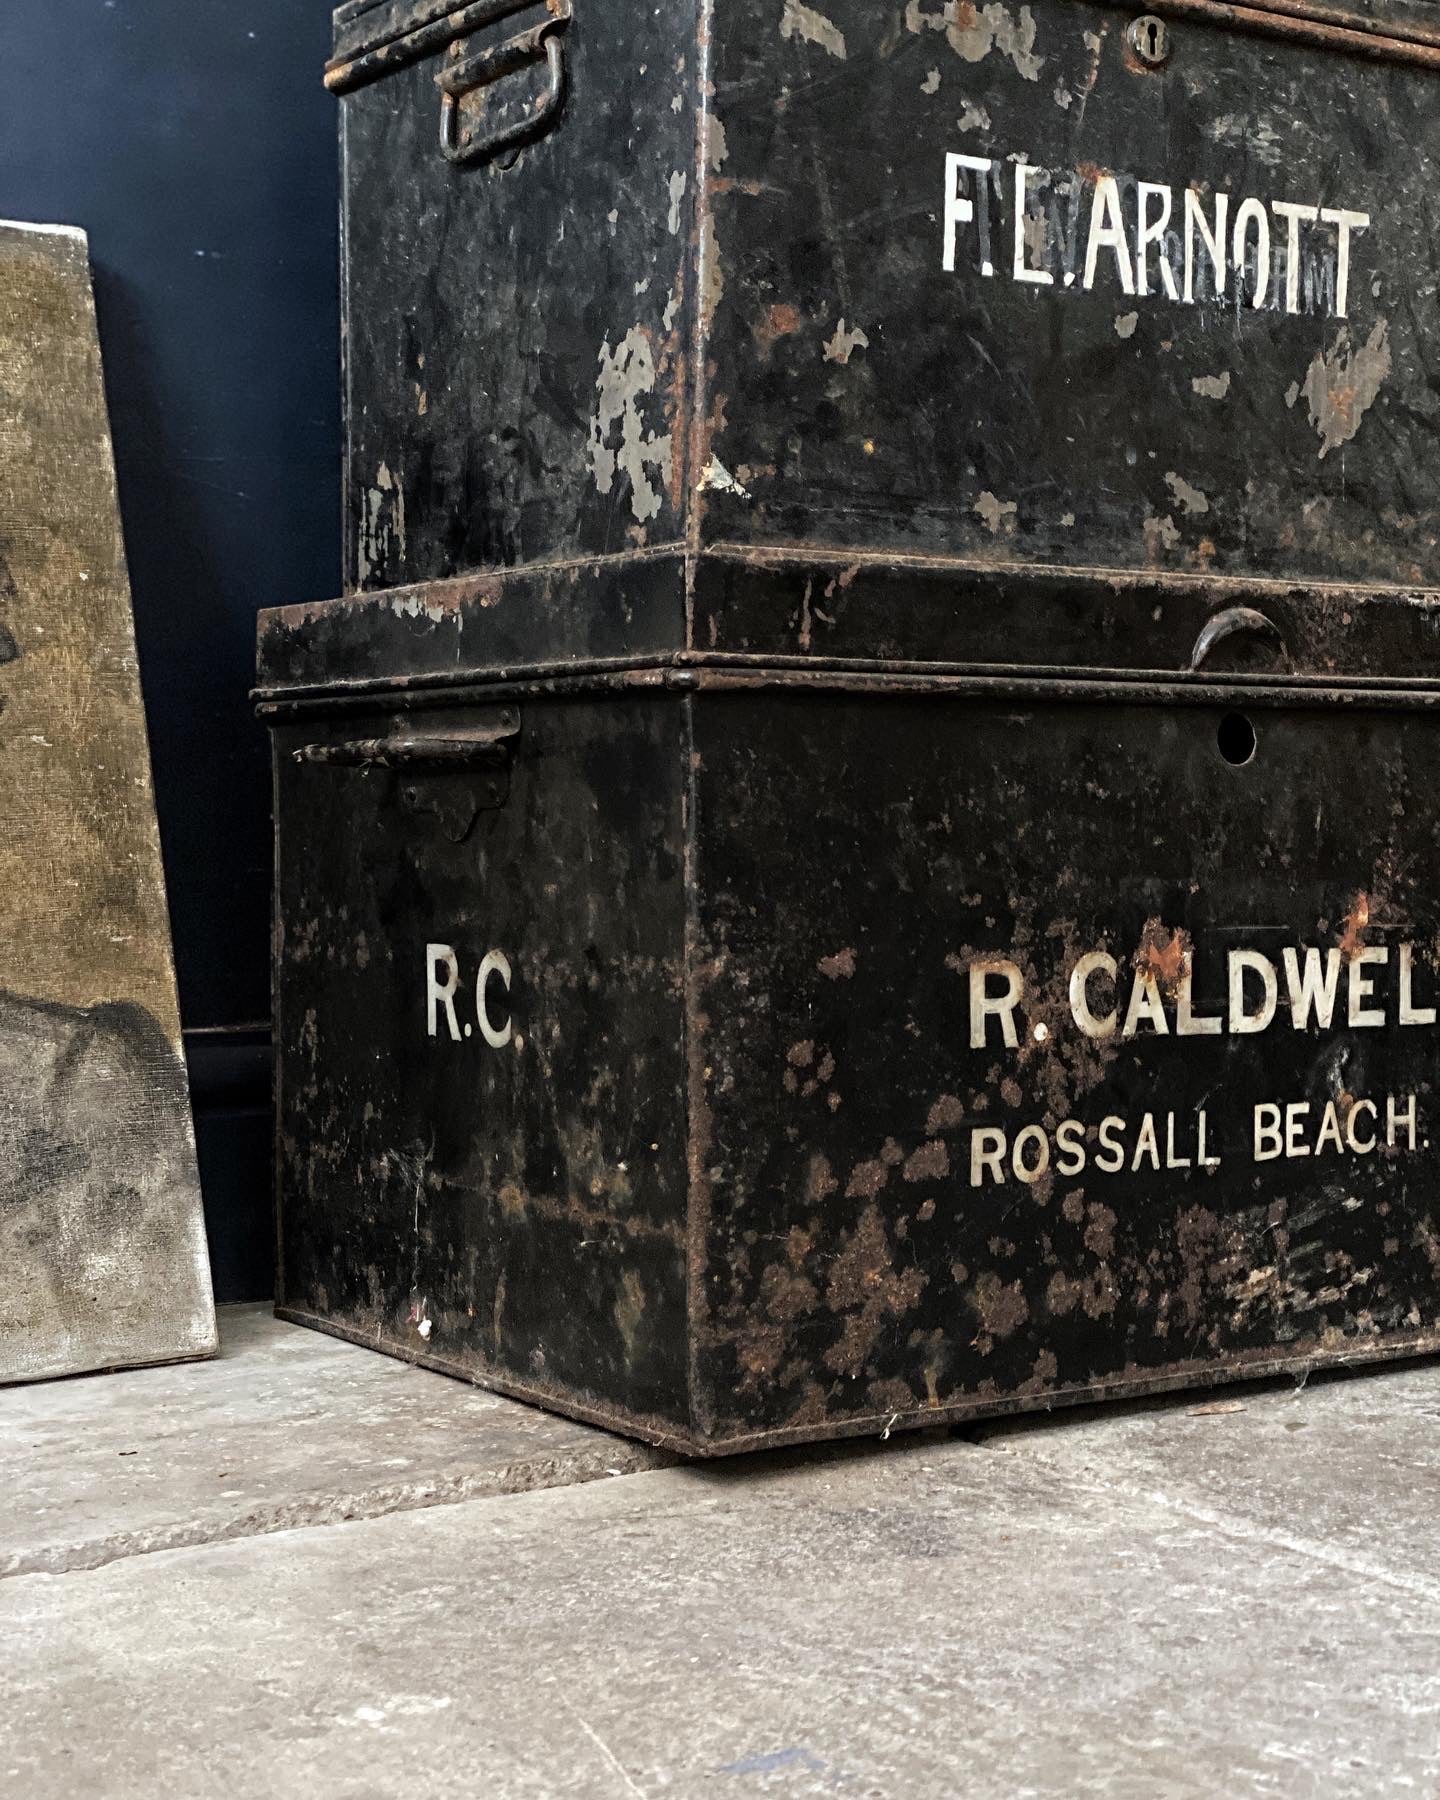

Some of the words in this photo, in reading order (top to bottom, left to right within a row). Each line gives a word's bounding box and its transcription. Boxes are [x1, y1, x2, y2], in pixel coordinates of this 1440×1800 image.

[970, 960, 1049, 1048] R.
[970, 1111, 1221, 1187] ROSSALL
[1254, 1095, 1430, 1160] BEACH.
